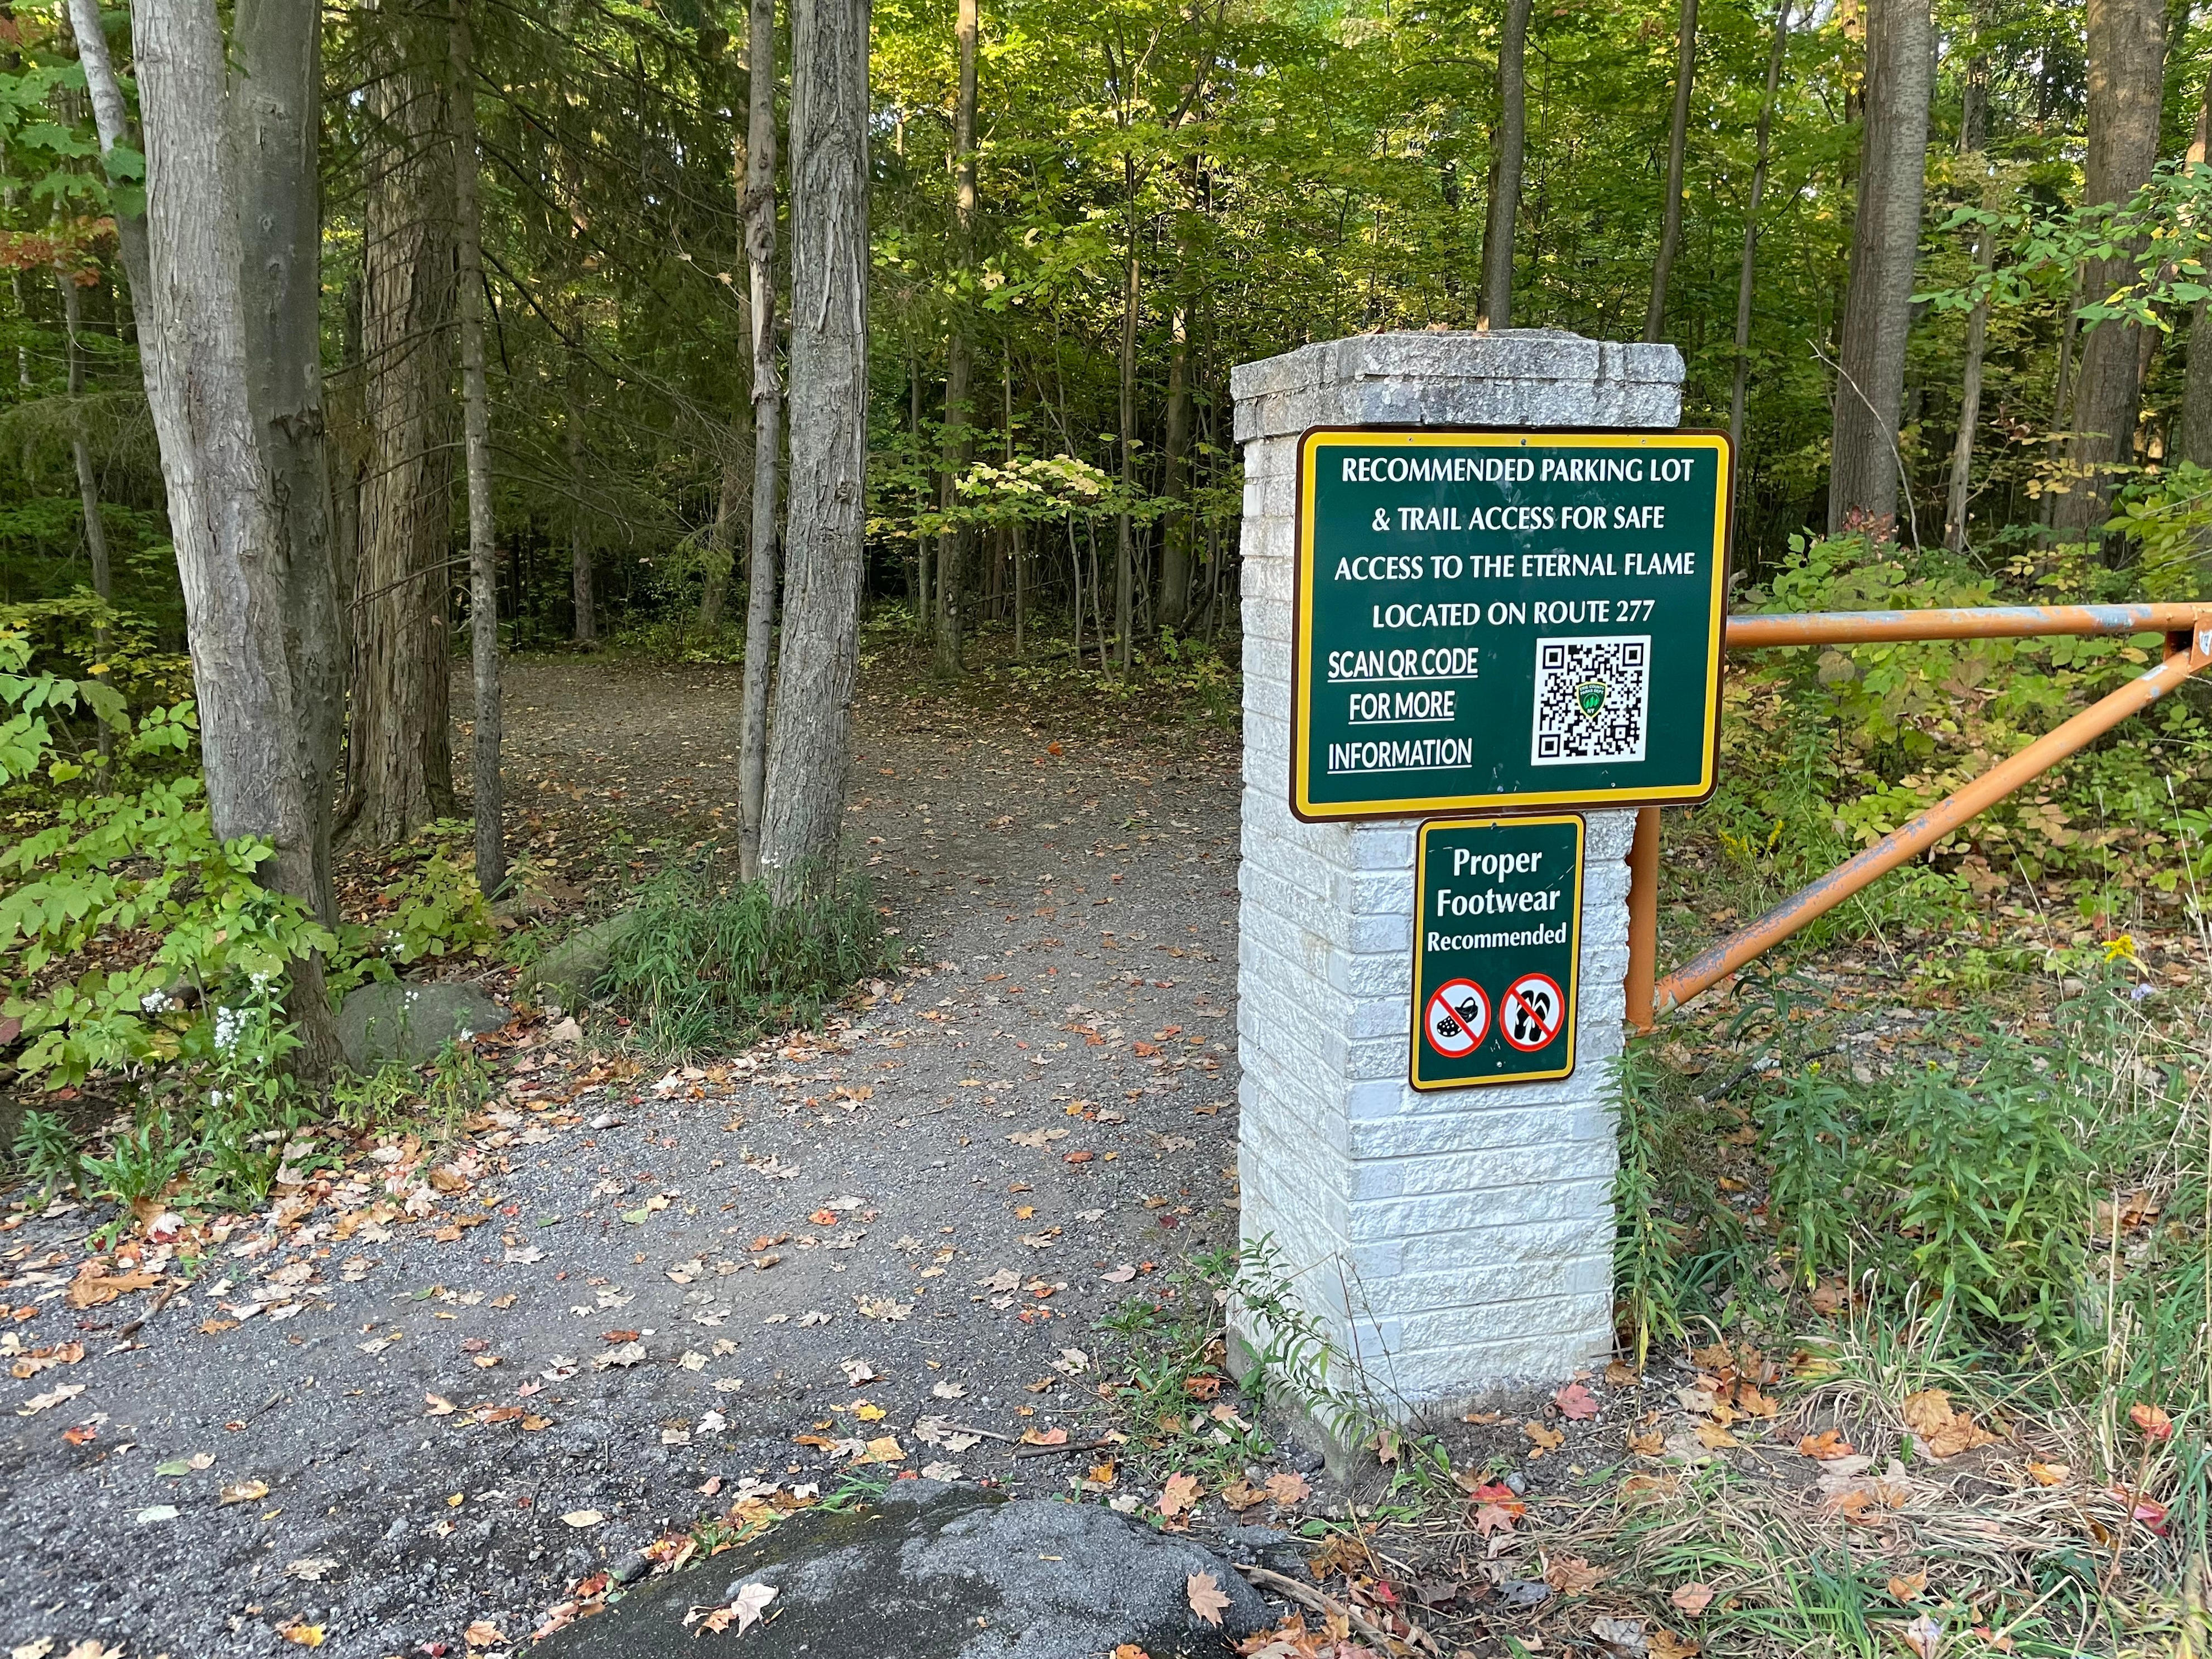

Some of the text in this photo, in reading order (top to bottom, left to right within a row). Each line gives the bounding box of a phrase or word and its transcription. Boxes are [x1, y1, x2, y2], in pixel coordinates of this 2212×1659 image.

[1342, 457, 1695, 482] RECOMMENDED PARKING LOT
[1371, 506, 1665, 531] & TRAIL ACCESS FOR SAFE
[1334, 552, 1695, 581] ACCESS TO THE ETERNAL FLAME
[1372, 599, 1656, 628] LOCATED ON ROUTE 277
[1327, 647, 1479, 678] SCAN QR CODE
[1350, 690, 1456, 720] FOR MORE
[1328, 737, 1472, 770] INFORMATION
[1453, 848, 1543, 883] Proper
[1437, 888, 1561, 917] Footwear
[1428, 922, 1567, 952] Recommended
